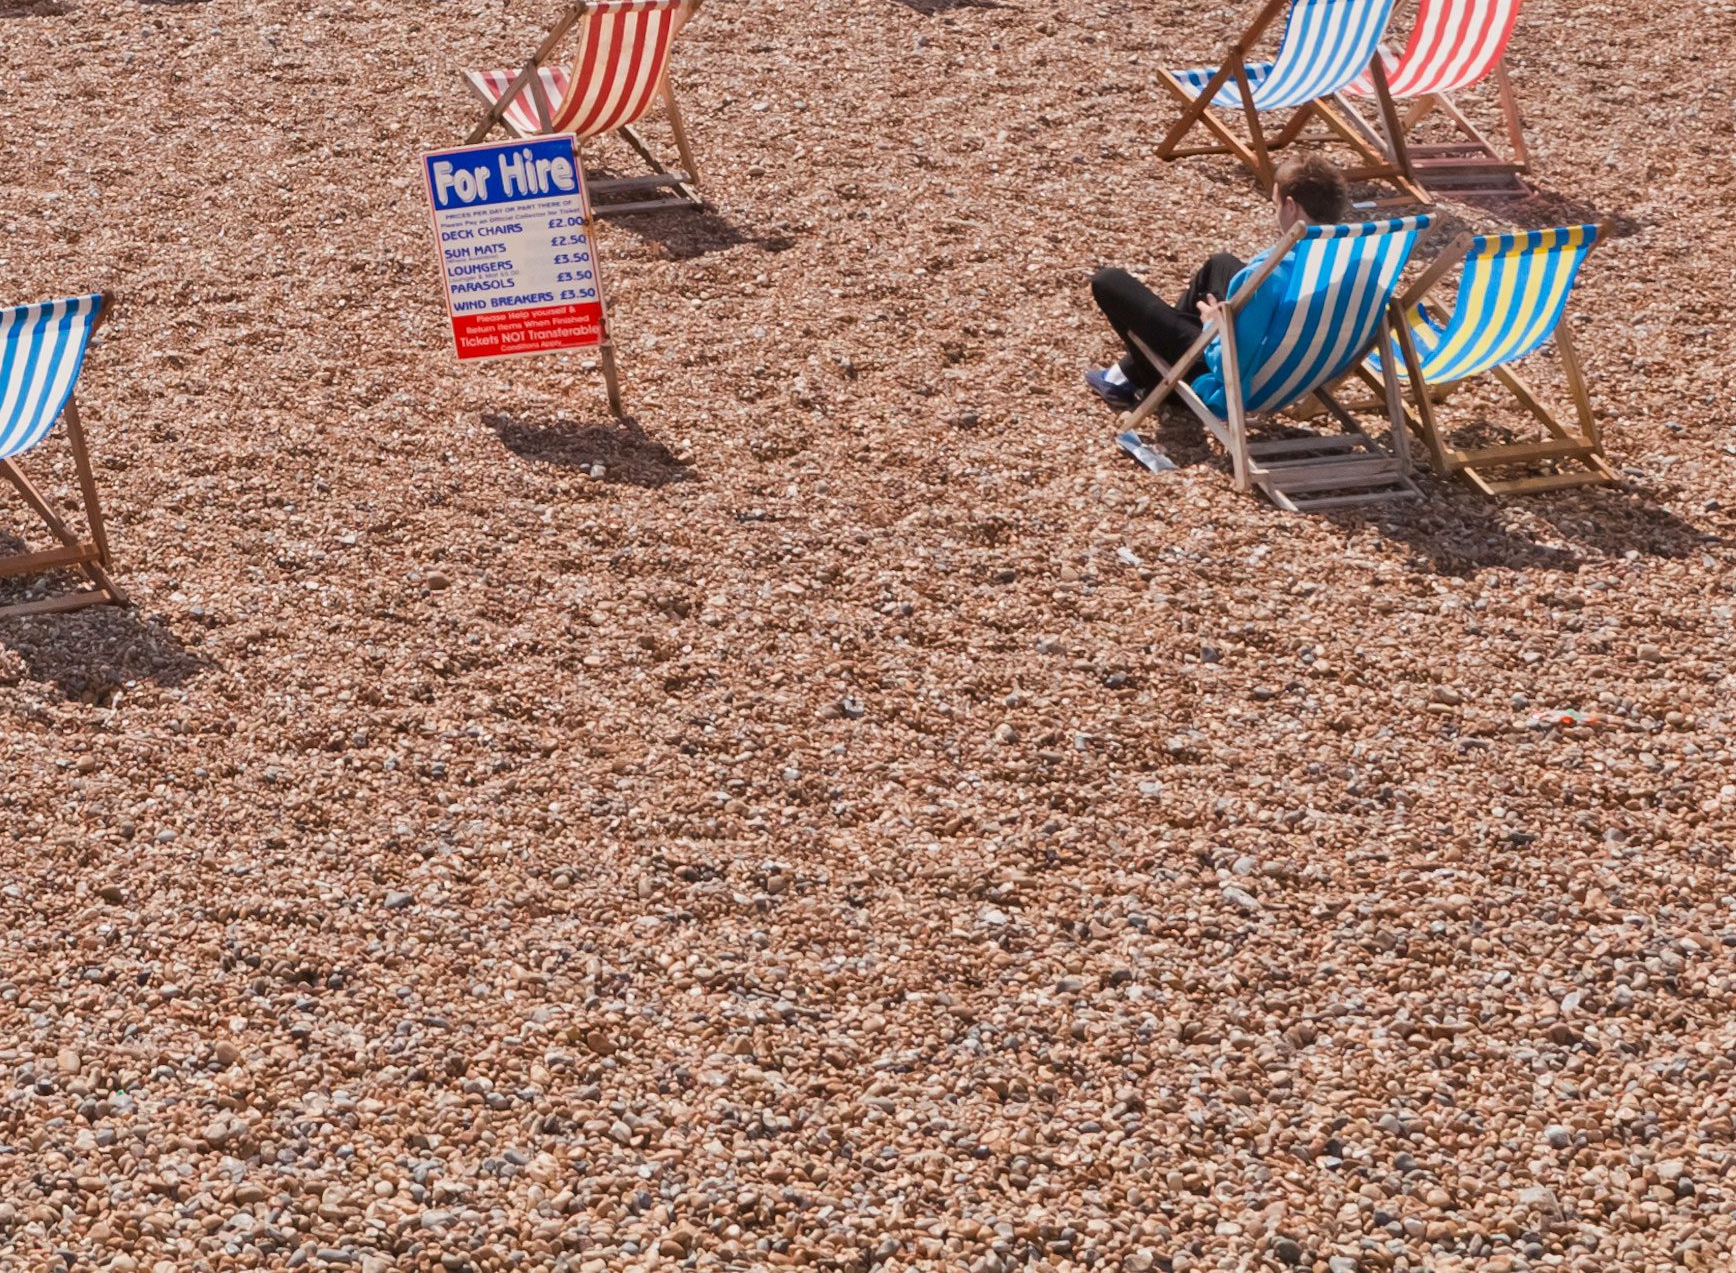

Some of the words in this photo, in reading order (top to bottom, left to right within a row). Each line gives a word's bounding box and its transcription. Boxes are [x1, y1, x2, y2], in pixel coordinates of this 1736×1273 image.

[432, 160, 491, 206] For
[498, 148, 575, 197] Hire
[517, 204, 536, 212] PART
[537, 202, 561, 210] THERE
[441, 229, 474, 242] DECK
[478, 223, 523, 237] CHAIRS
[548, 216, 584, 229] £2.00
[444, 248, 470, 259] SUN
[475, 243, 506, 256] MATS
[551, 234, 586, 246] £2.50
[448, 260, 513, 277] LOUNGERS
[554, 252, 589, 264] £3.50
[451, 278, 515, 294] PARASOLS
[557, 270, 593, 282] £3.50
[454, 299, 487, 311] WIND
[491, 292, 554, 308] BREAKERS
[560, 288, 596, 300] £3.50
[466, 324, 495, 335] Return
[552, 315, 589, 325] Finished
[476, 312, 506, 323] Please
[508, 311, 530, 321] Help
[460, 335, 499, 347] Tickets
[501, 331, 525, 343] NOT
[529, 324, 600, 340] Transferable
